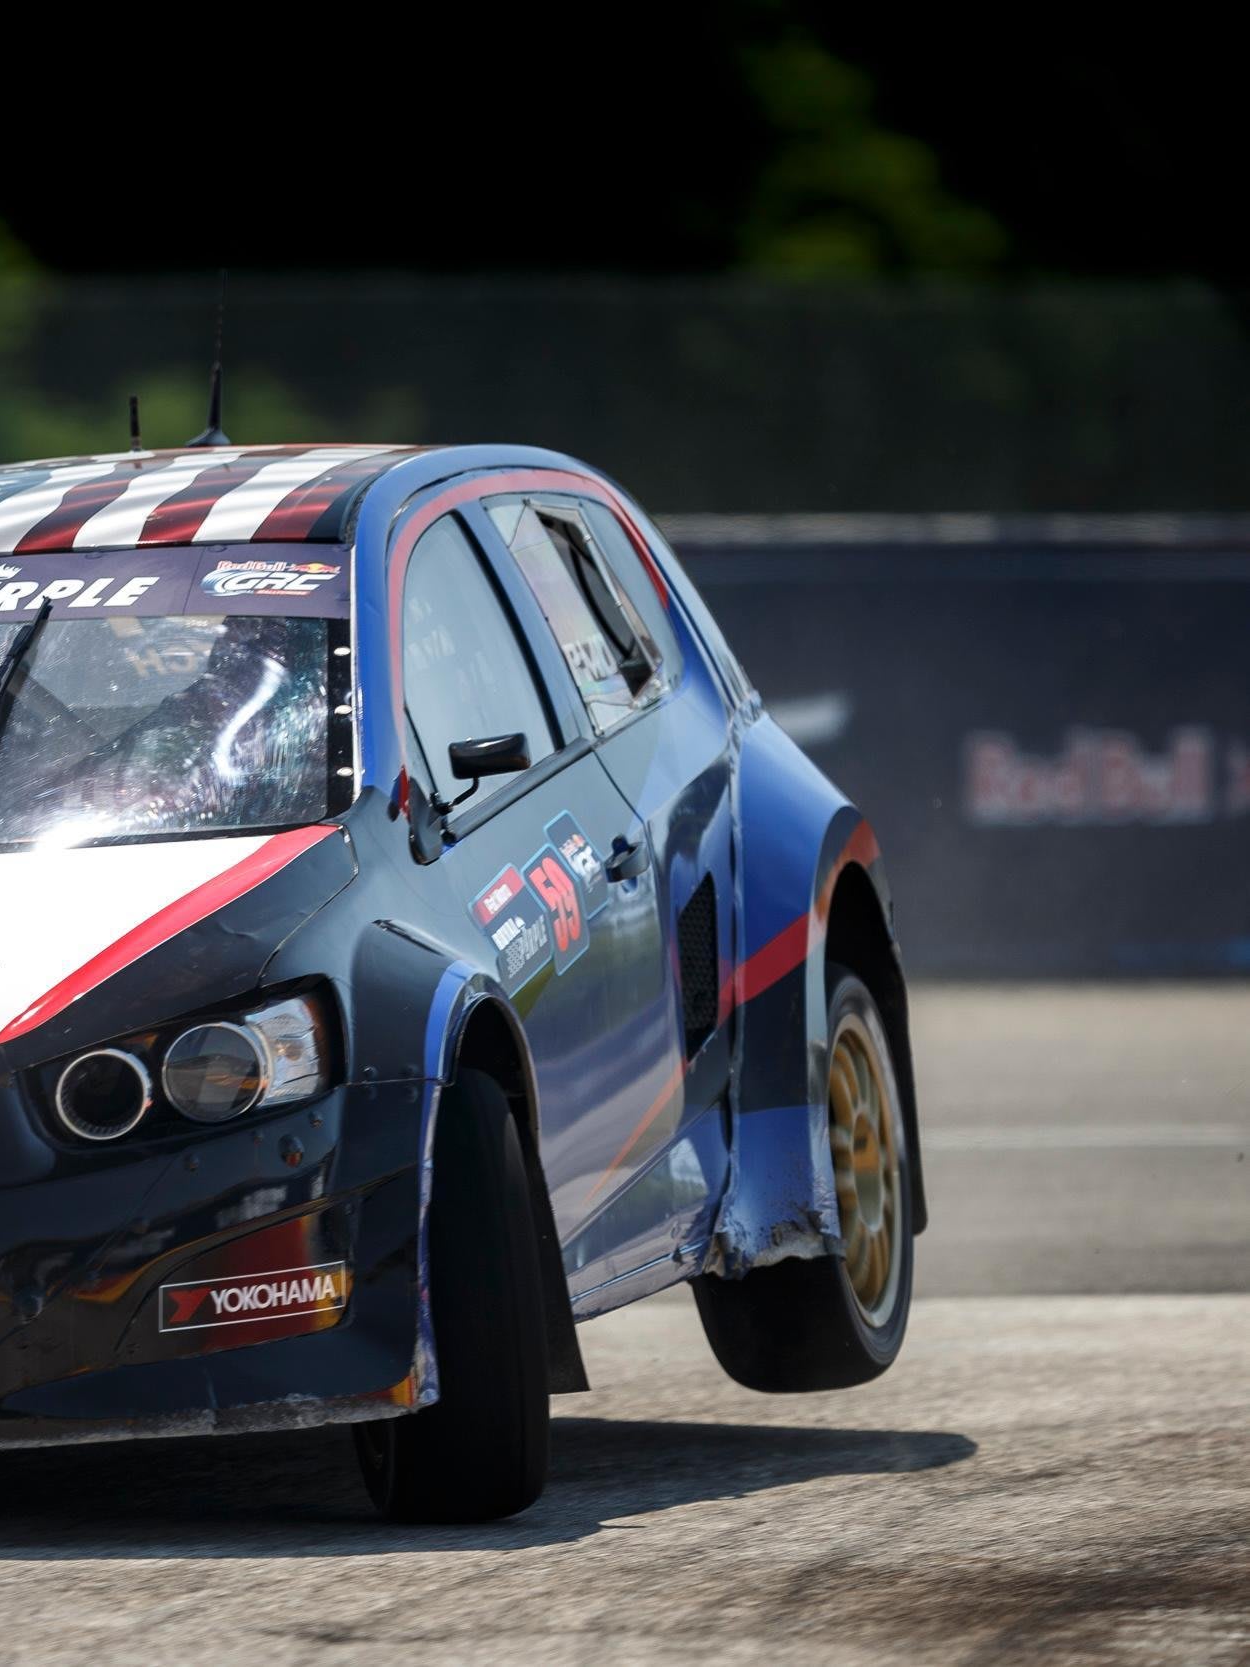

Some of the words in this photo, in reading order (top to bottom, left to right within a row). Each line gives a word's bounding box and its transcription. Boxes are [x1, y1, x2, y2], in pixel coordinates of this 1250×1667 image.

[218, 571, 337, 592] GRC
[529, 856, 581, 952] 59
[210, 1274, 337, 1315] YOKOHAMA
